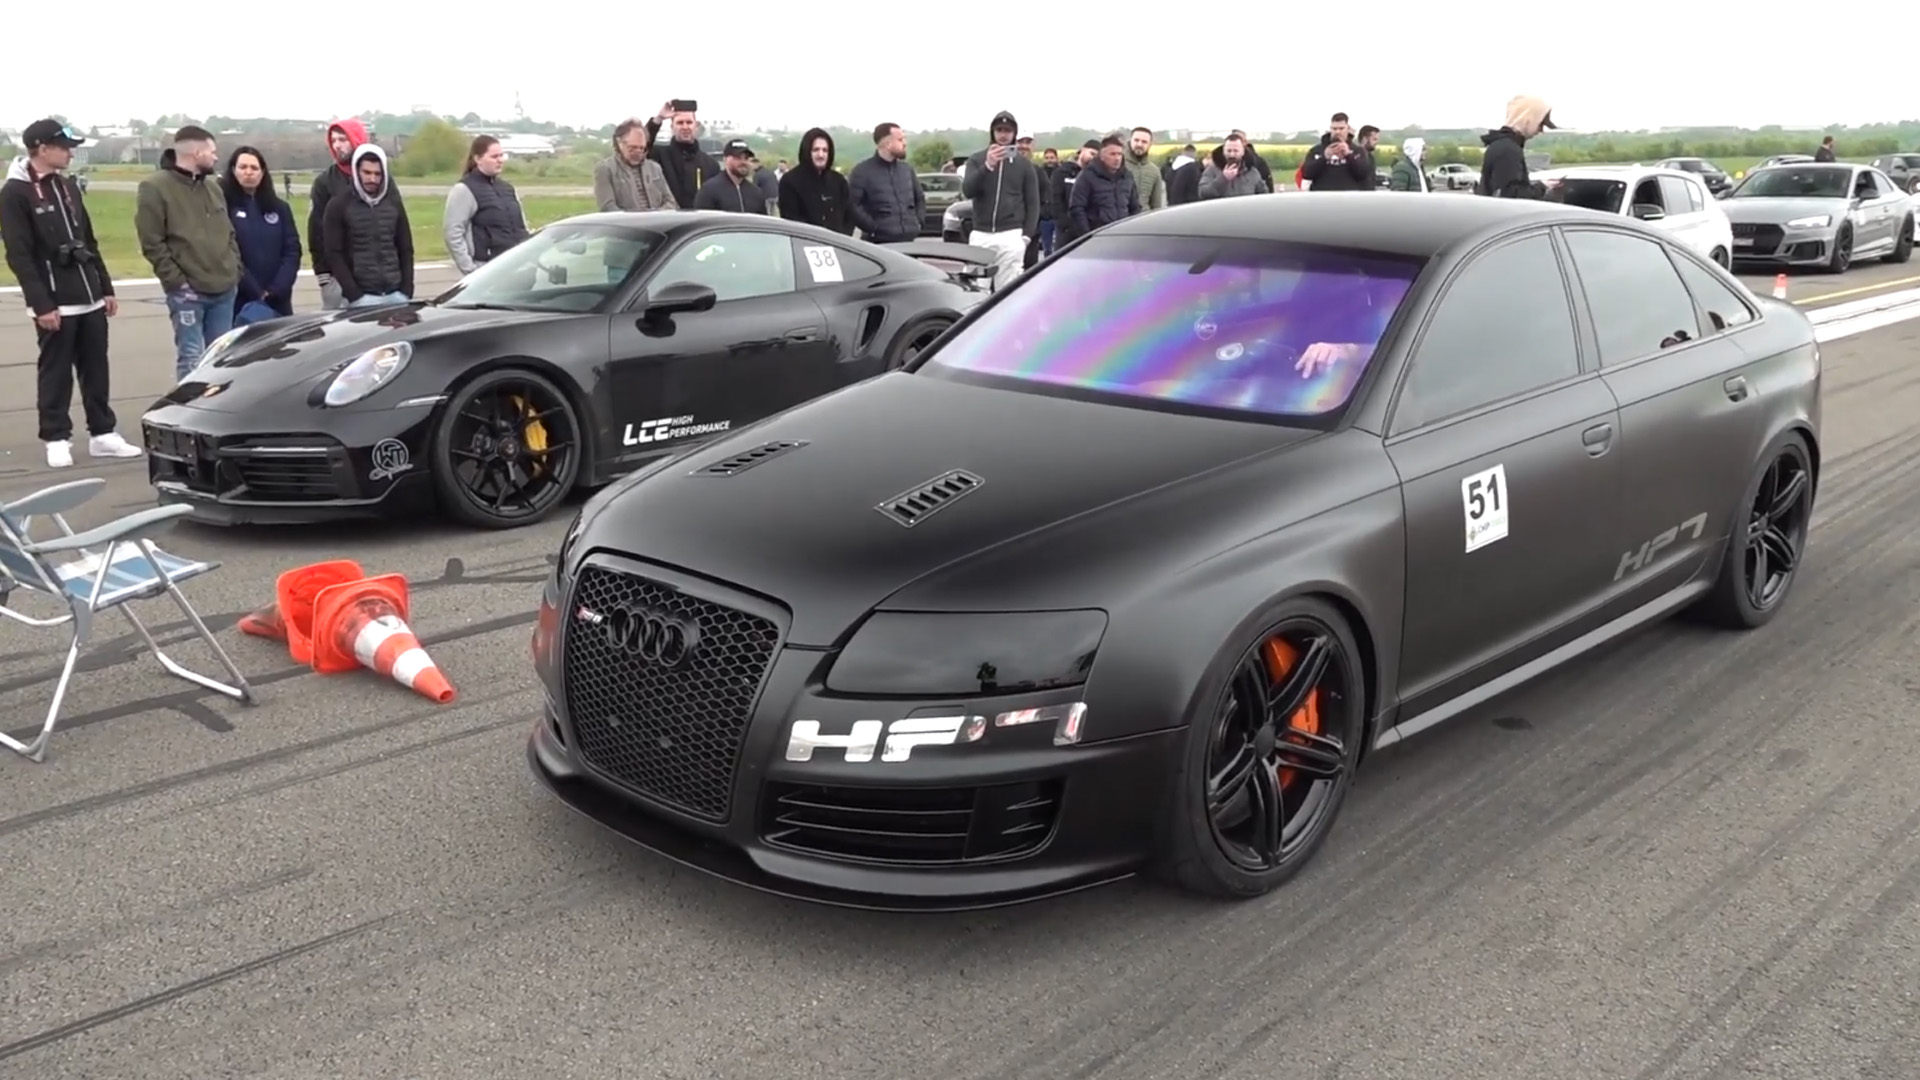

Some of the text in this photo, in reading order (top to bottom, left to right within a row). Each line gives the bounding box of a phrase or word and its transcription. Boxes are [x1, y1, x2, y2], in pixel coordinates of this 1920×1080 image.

[810, 249, 835, 267] 38
[669, 420, 730, 438] PERFORMANCE
[672, 414, 694, 426] HIGH
[1468, 473, 1500, 520] 51
